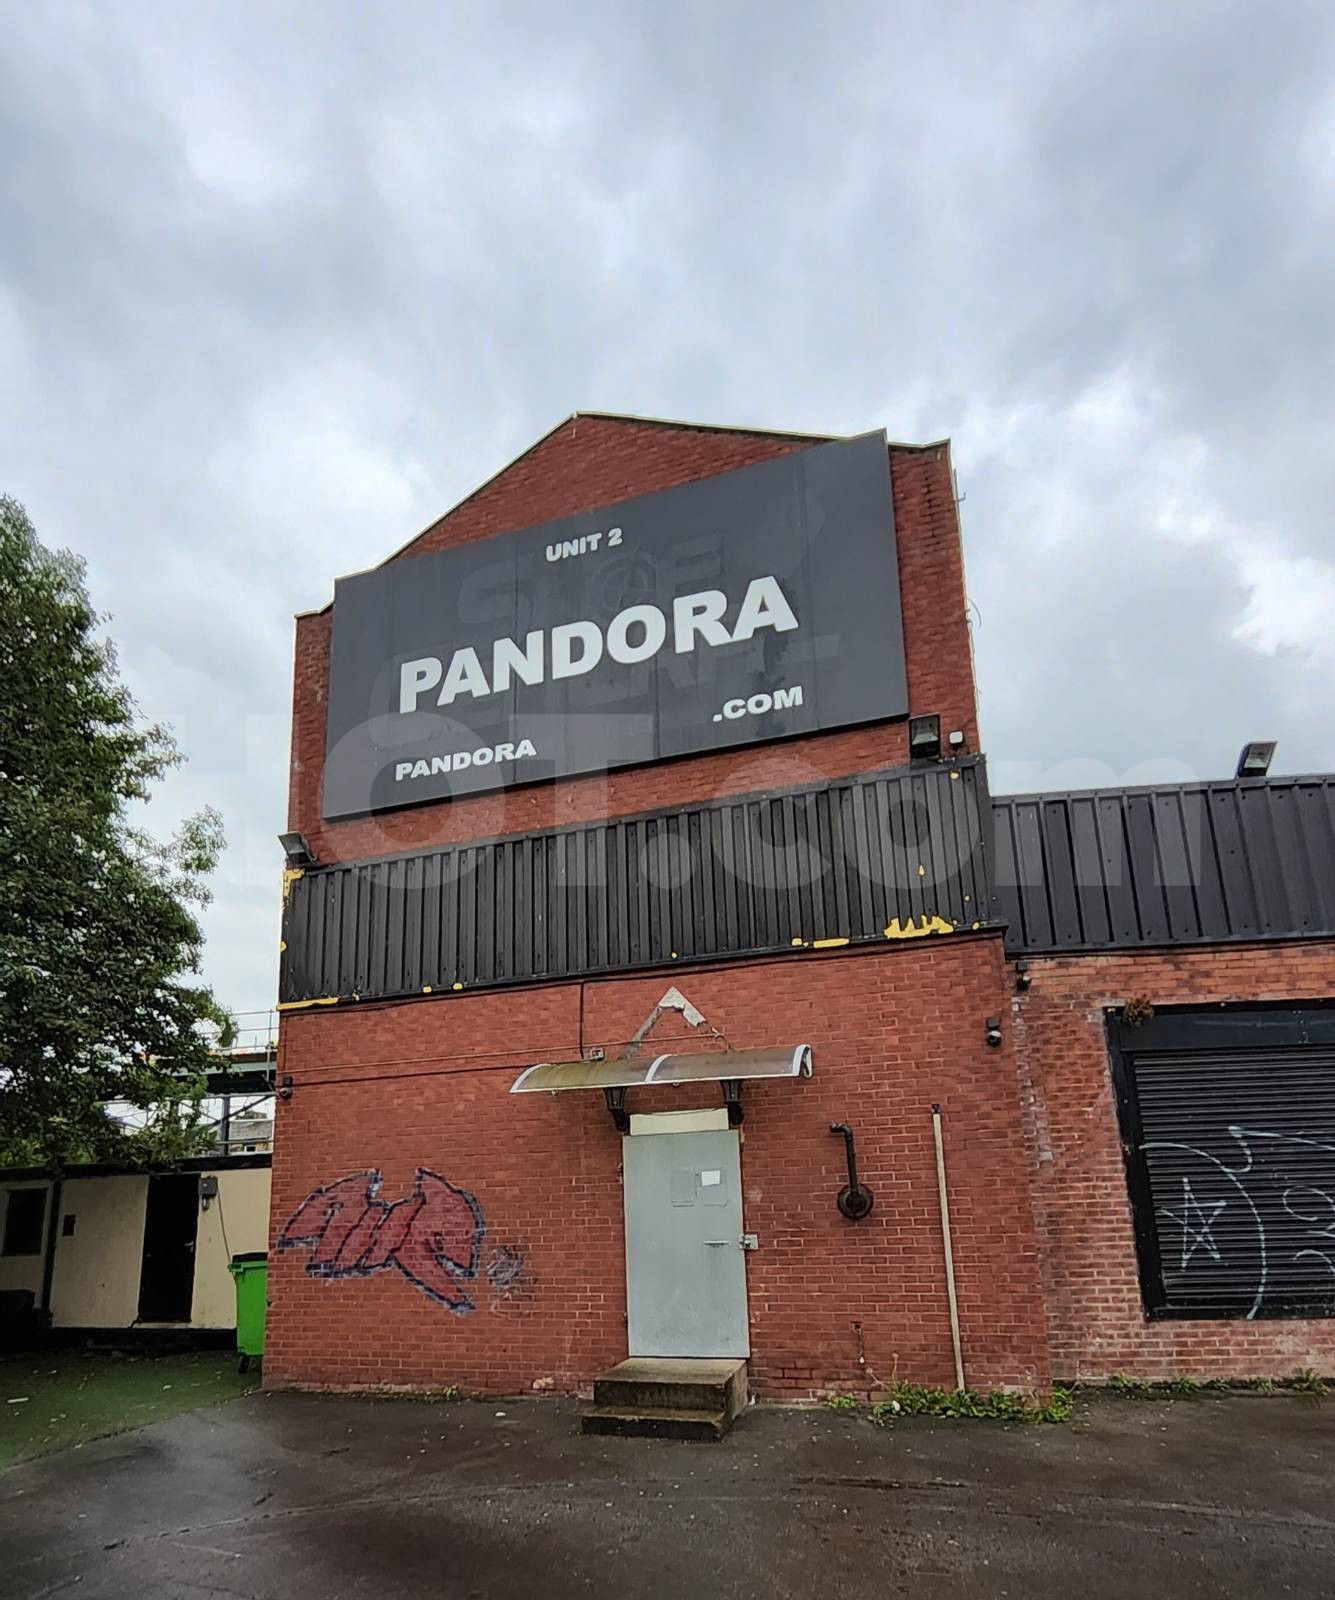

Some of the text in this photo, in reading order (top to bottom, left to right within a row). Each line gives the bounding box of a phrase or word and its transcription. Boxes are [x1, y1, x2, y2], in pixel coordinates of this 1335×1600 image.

[545, 527, 623, 563] UNIT 2
[398, 575, 799, 715] PANDORA
[712, 685, 804, 723] .COM
[394, 738, 537, 783] PANDORA
